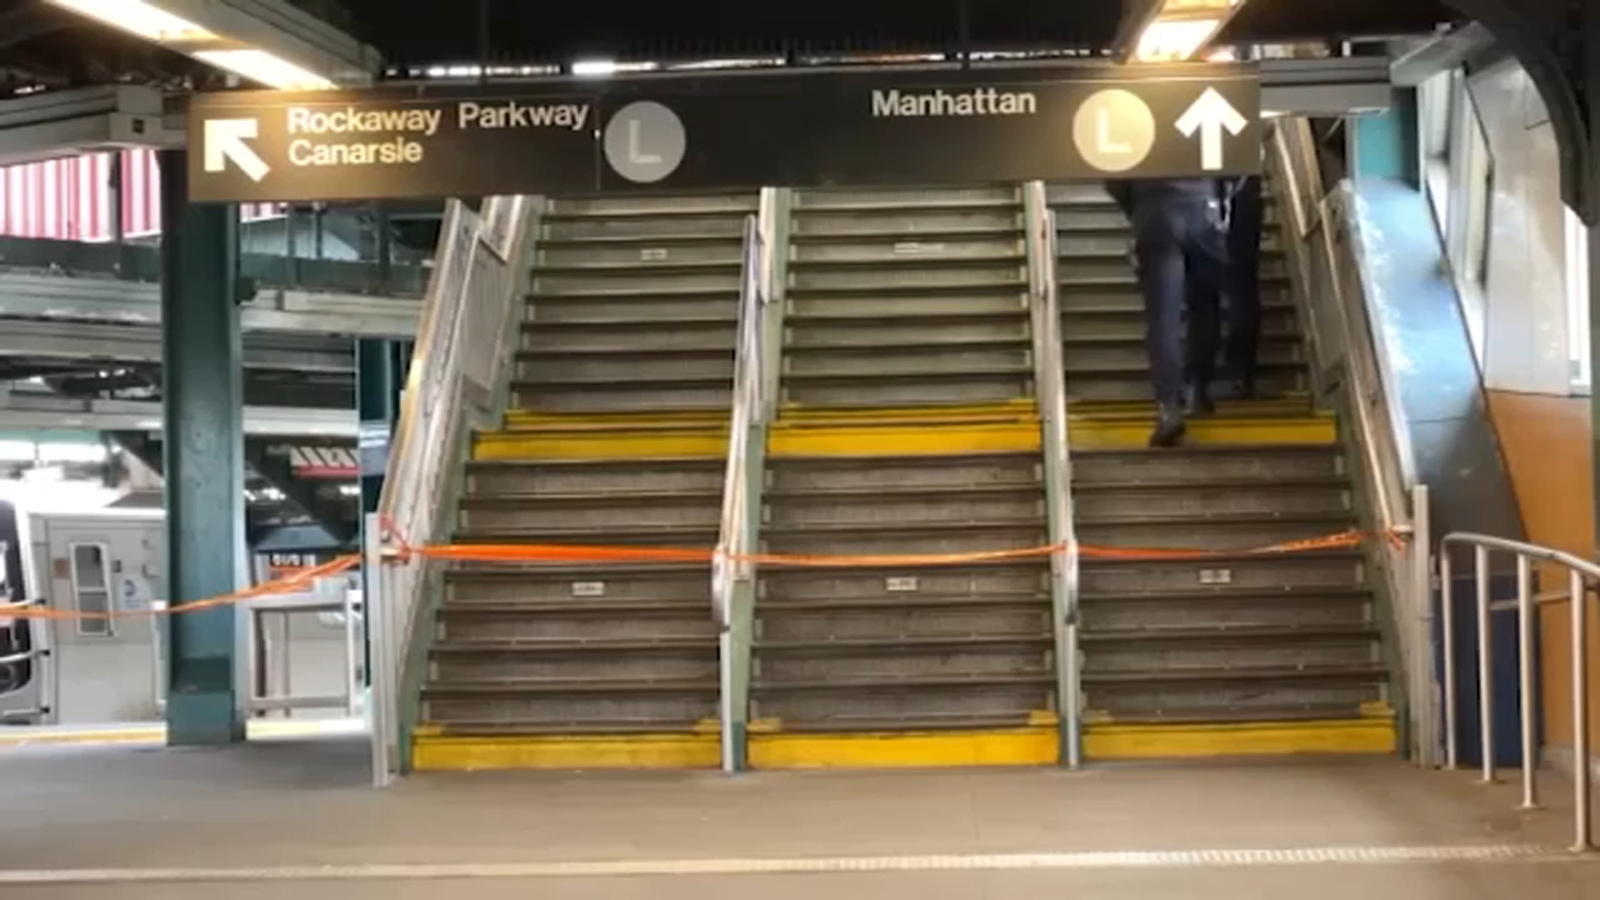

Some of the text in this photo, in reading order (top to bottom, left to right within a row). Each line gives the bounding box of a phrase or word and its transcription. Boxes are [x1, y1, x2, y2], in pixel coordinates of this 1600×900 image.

[288, 101, 589, 136] Rockaway Parkway
[871, 88, 1036, 117] Manhattan
[629, 119, 662, 164] L
[1096, 108, 1133, 152] L
[289, 138, 423, 166] Canarsie
